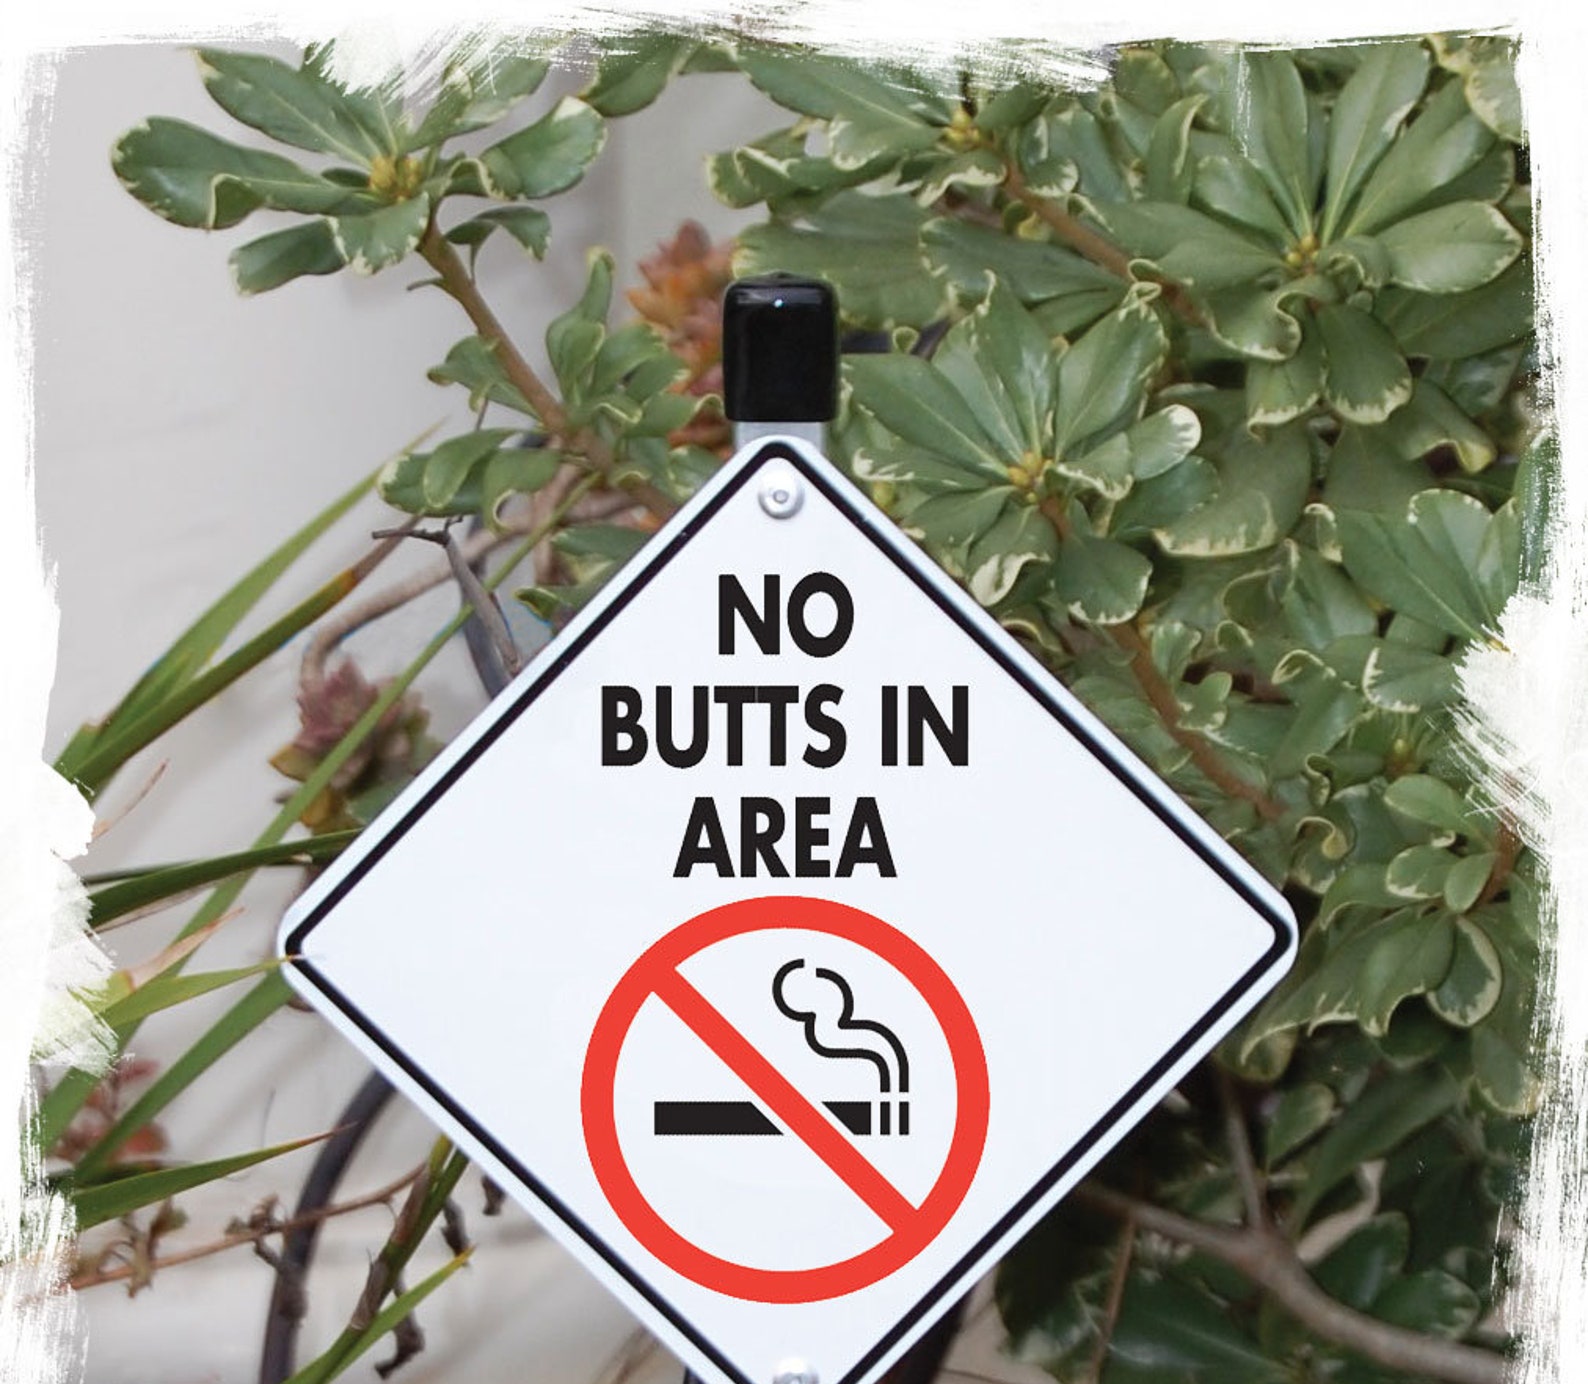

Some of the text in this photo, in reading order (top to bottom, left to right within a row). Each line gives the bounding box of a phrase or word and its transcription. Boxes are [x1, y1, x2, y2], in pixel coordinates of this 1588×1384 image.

[719, 571, 854, 658] NO
[601, 684, 969, 769] BUTTS IN
[673, 797, 897, 878] AREA
